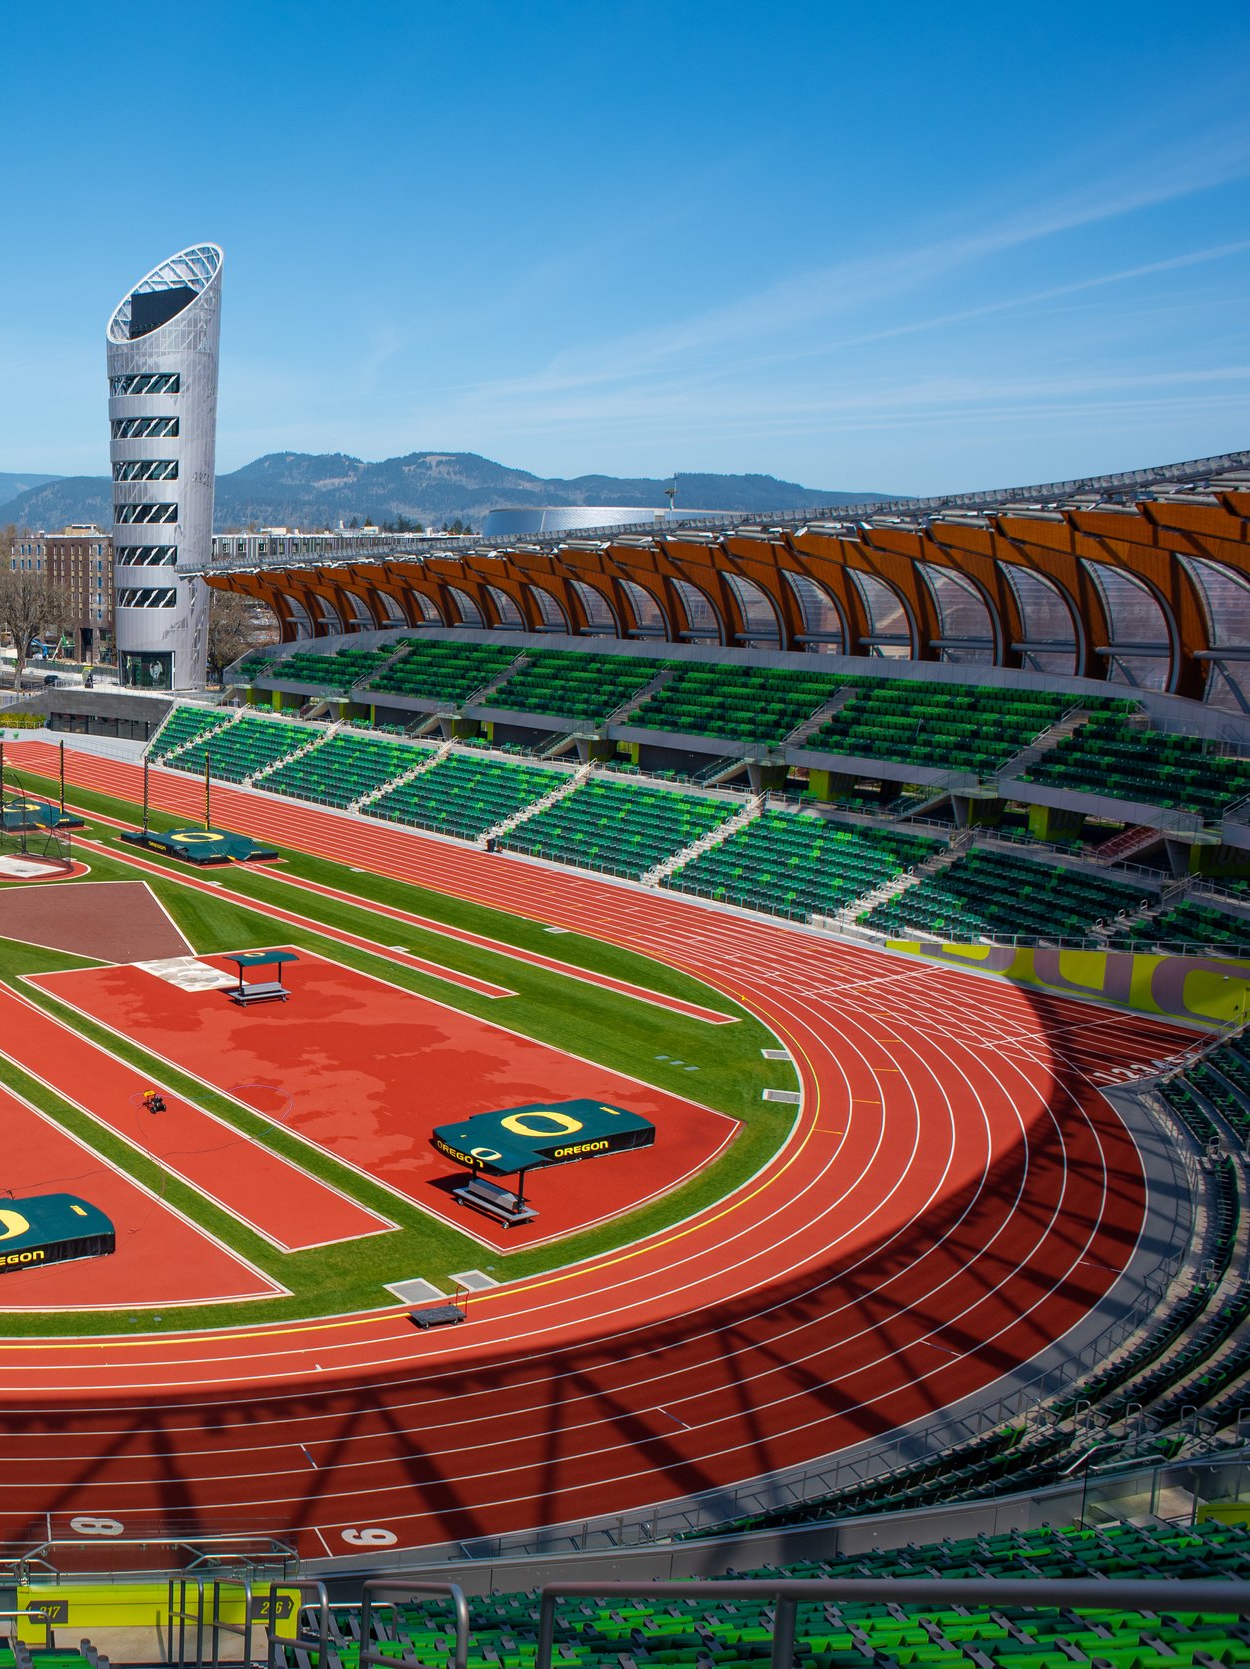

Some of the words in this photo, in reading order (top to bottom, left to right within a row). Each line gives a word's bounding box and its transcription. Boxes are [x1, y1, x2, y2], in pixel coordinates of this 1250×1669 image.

[501, 1111, 583, 1137] O
[554, 1140, 609, 1158] OREGON
[70, 1516, 125, 1536] 8
[341, 1528, 398, 1546] 9
[37, 1605, 61, 1619] 217
[260, 1601, 283, 1614] 26
